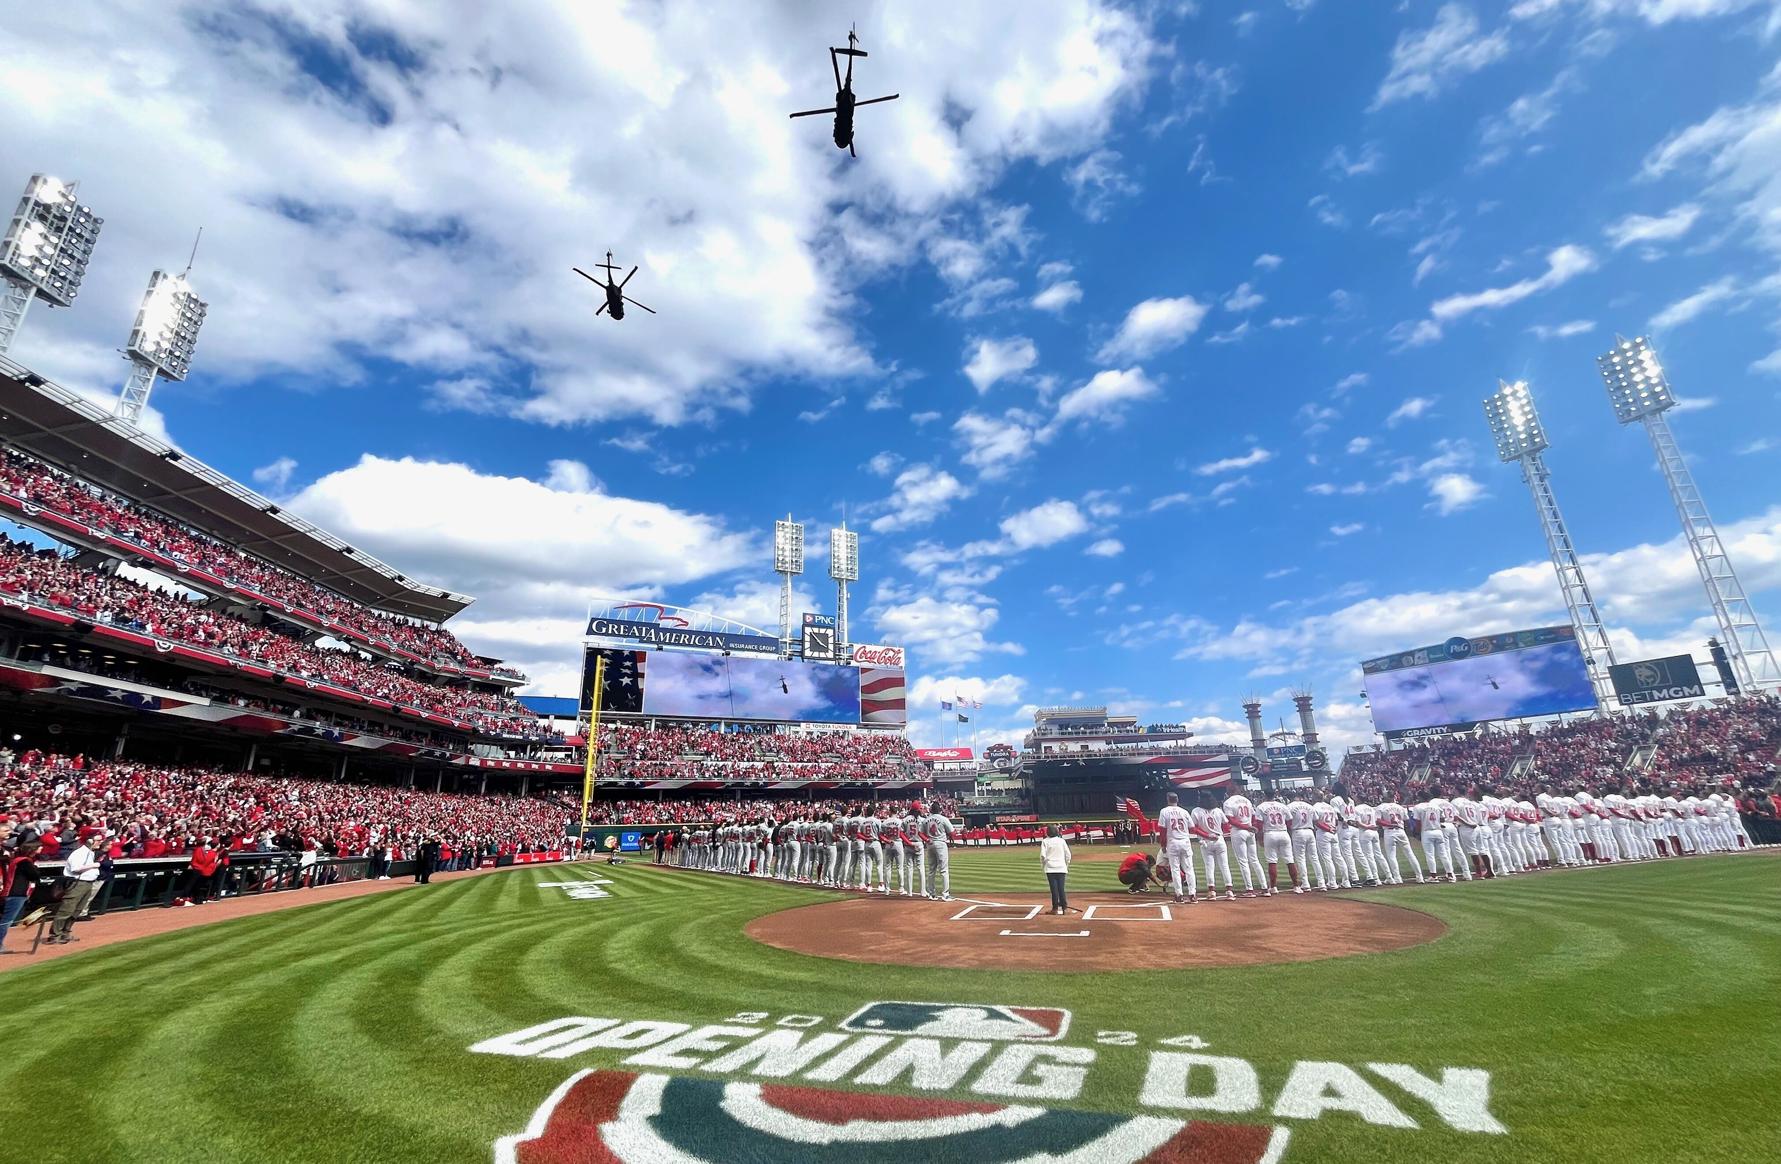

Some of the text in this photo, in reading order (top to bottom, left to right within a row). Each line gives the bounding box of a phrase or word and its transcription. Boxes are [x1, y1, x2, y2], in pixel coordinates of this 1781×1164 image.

[815, 615, 834, 625] PNC
[592, 620, 649, 637] GREAT
[643, 628, 725, 648] AMERICAN
[729, 643, 758, 651] INSURANCE
[1450, 642, 1468, 654] P&G
[1620, 684, 1702, 705] BETMGM
[1406, 726, 1448, 737] GRAVITY
[1269, 812, 1283, 825] 33
[1301, 812, 1308, 824] 3
[909, 824, 917, 836] 5
[1170, 818, 1185, 832] 25
[723, 1012, 1210, 1049] 20 24
[467, 1015, 1510, 1135] OPENING DAY
